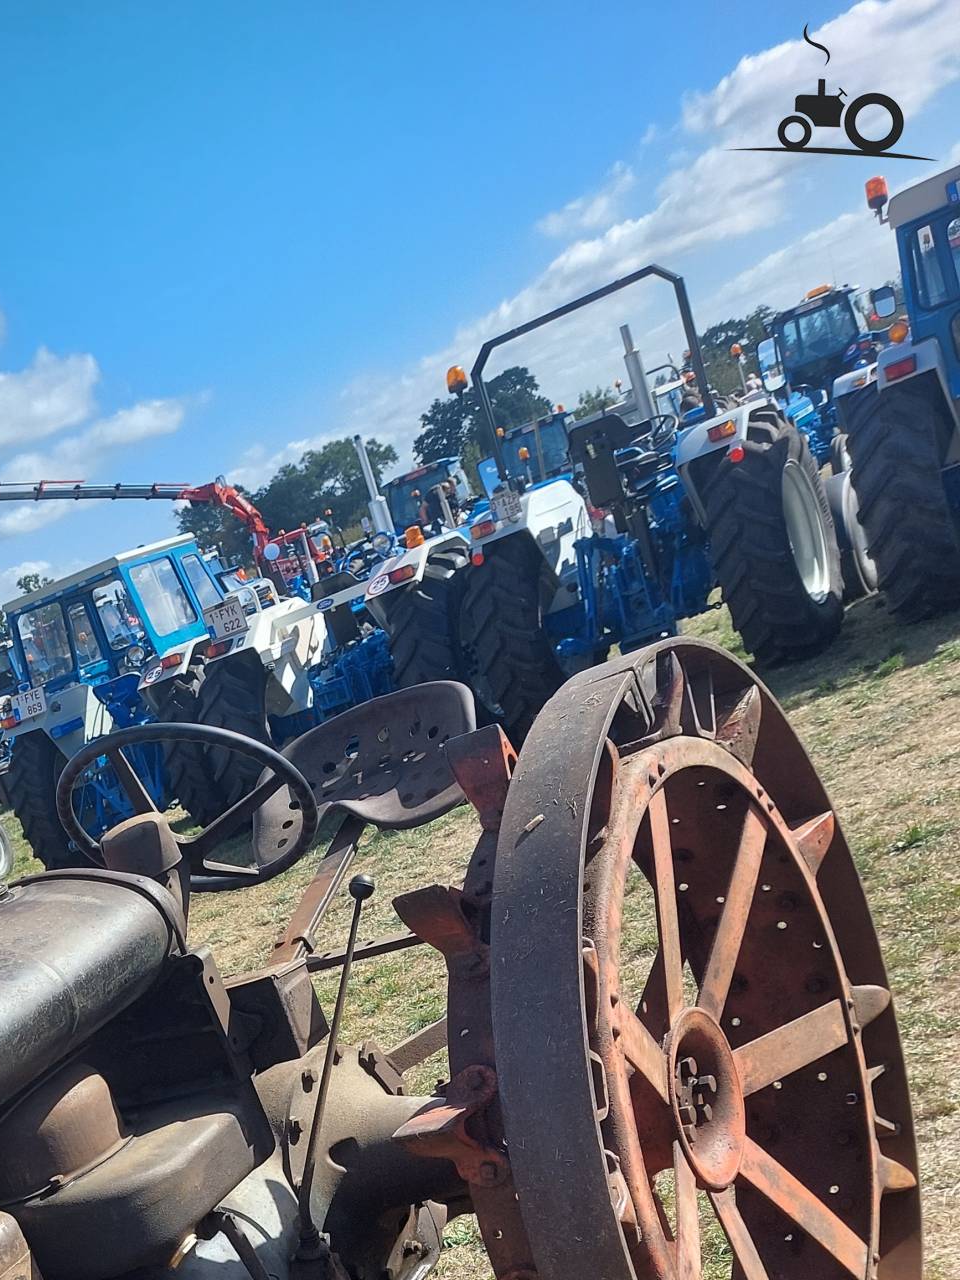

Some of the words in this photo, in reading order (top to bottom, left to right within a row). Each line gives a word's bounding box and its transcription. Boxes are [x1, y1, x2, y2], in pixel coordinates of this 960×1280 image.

[223, 617, 242, 633] 622
[146, 668, 161, 680] 25
[27, 701, 43, 716] 869
